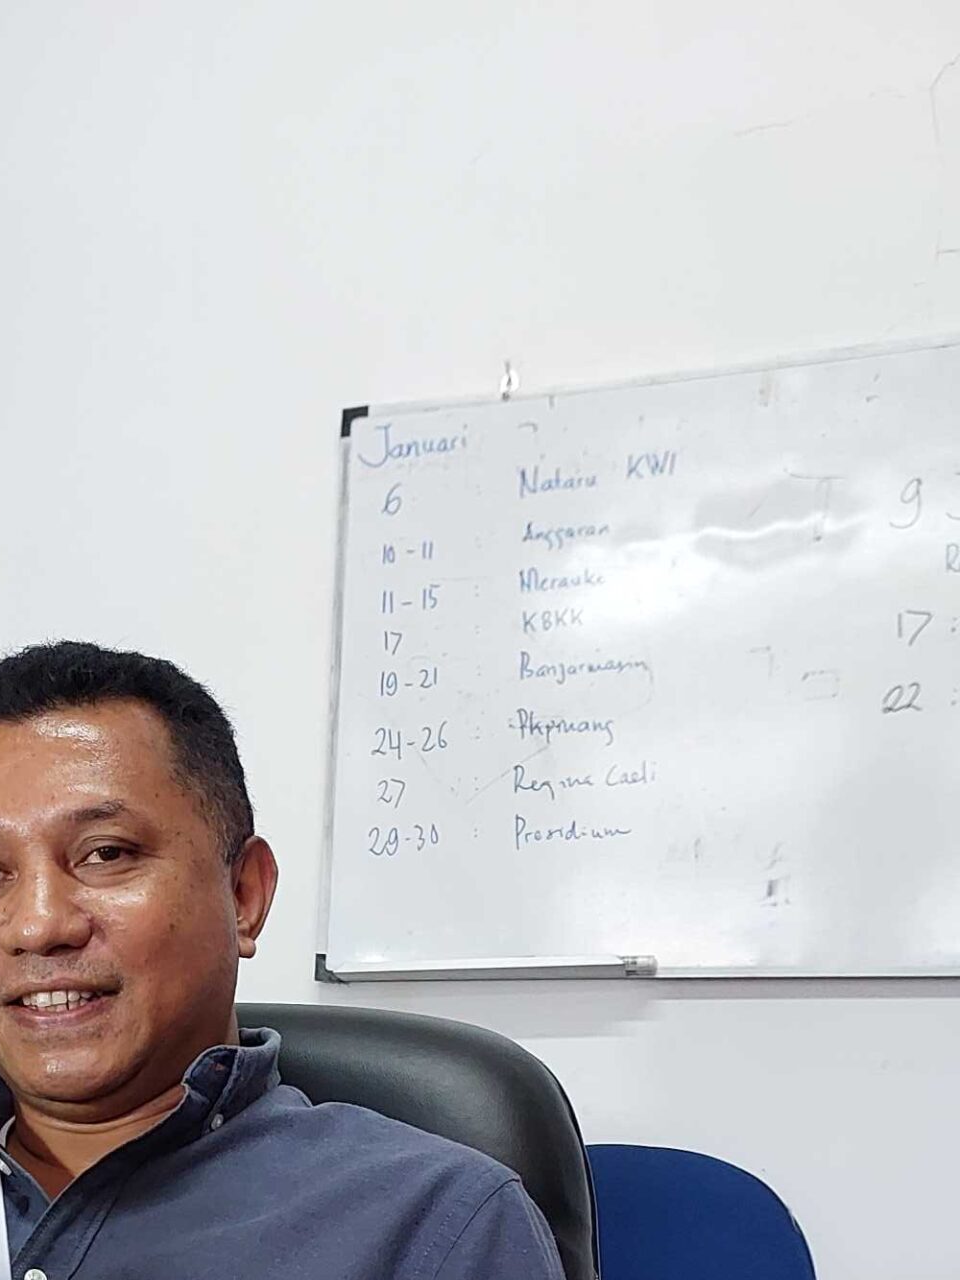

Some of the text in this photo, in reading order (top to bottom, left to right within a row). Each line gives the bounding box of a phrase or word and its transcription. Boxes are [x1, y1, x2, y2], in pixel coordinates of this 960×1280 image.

[358, 423, 467, 468] Januari
[381, 483, 402, 515] 6
[626, 451, 677, 479] KWI
[889, 477, 923, 530] 9
[384, 631, 403, 656] 17
[882, 682, 923, 714] 22
[377, 778, 406, 808] 27
